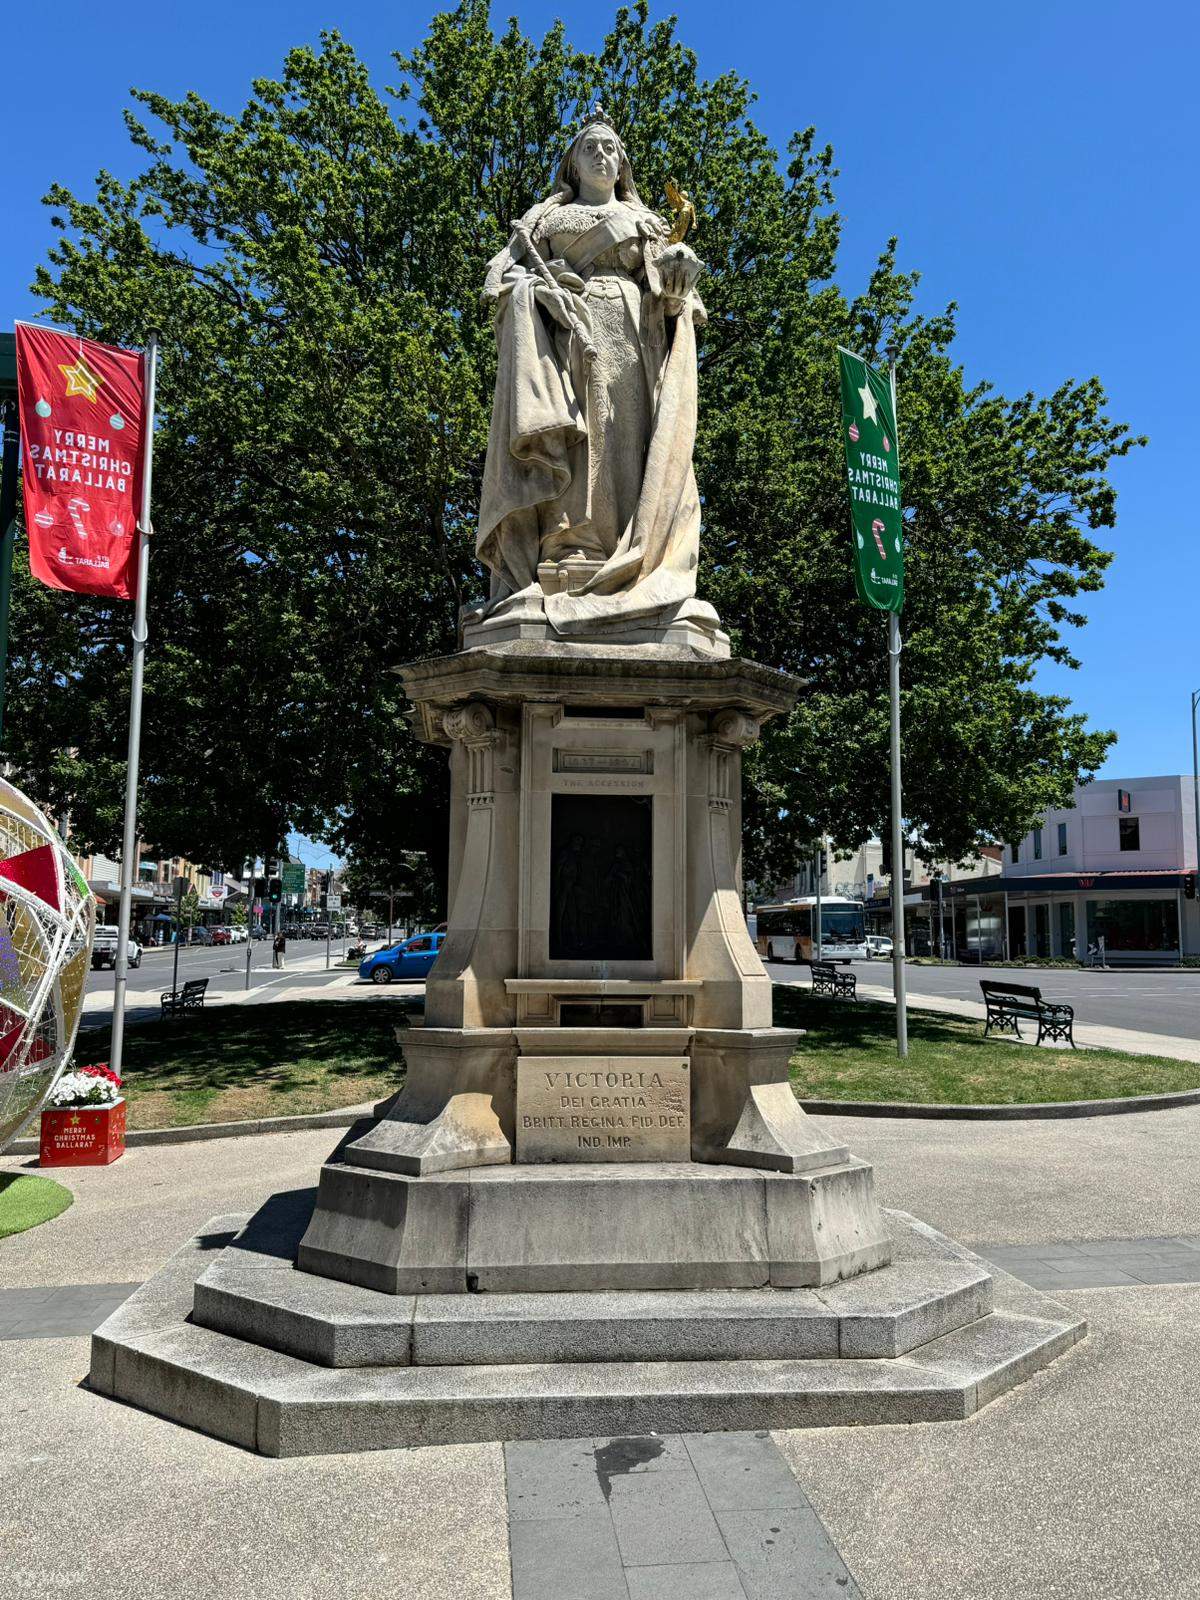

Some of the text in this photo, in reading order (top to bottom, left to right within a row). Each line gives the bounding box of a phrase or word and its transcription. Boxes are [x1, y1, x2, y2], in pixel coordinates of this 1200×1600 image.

[544, 1072, 664, 1089] VICTORIA
[560, 1096, 647, 1108] DEI GRATIA
[56, 1141, 94, 1149] BALLARAT
